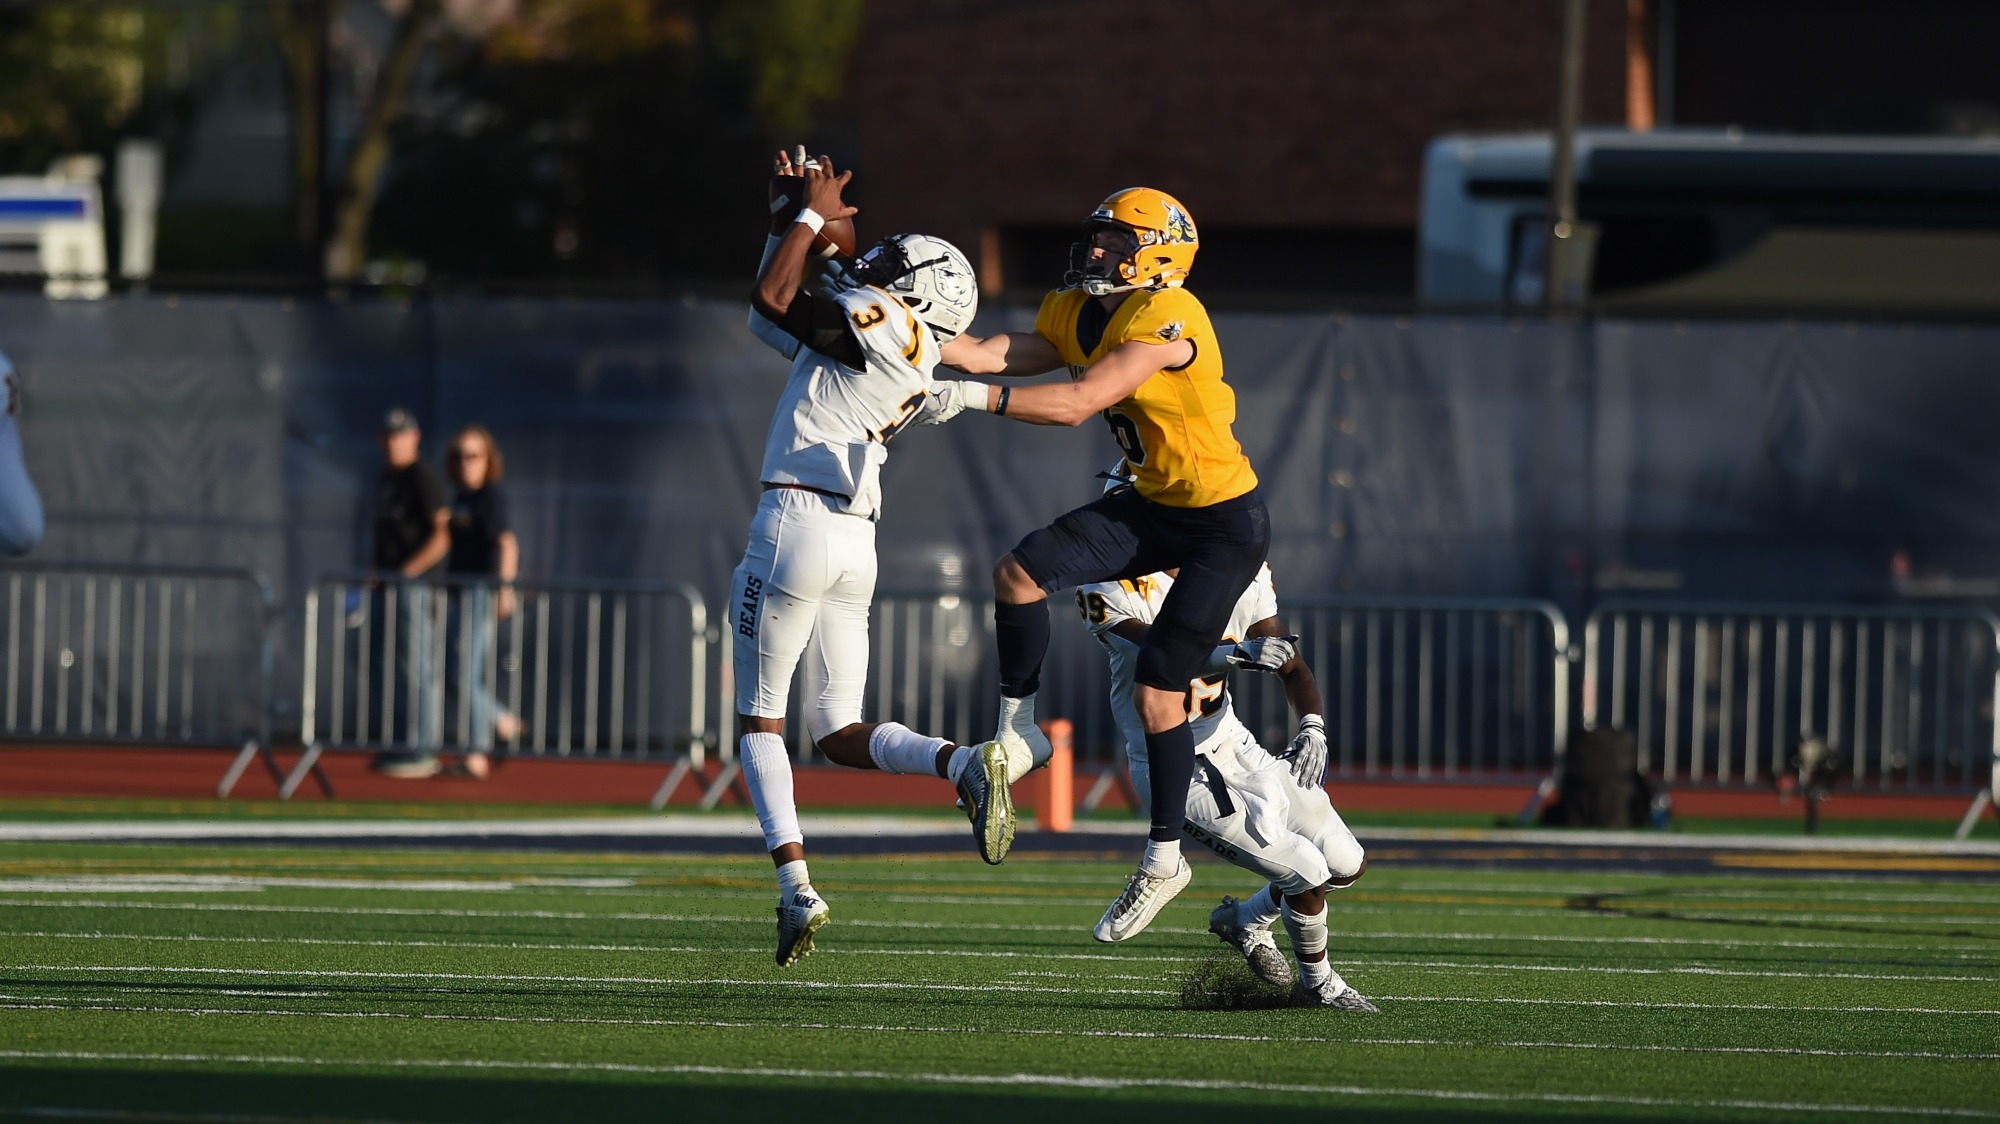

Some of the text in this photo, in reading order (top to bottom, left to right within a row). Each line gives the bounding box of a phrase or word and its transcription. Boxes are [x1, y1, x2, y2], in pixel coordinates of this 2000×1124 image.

[851, 303, 888, 332] 3
[739, 575, 763, 640] BEARS
[1182, 821, 1238, 860] BEARS
[791, 893, 820, 909] NIKE
